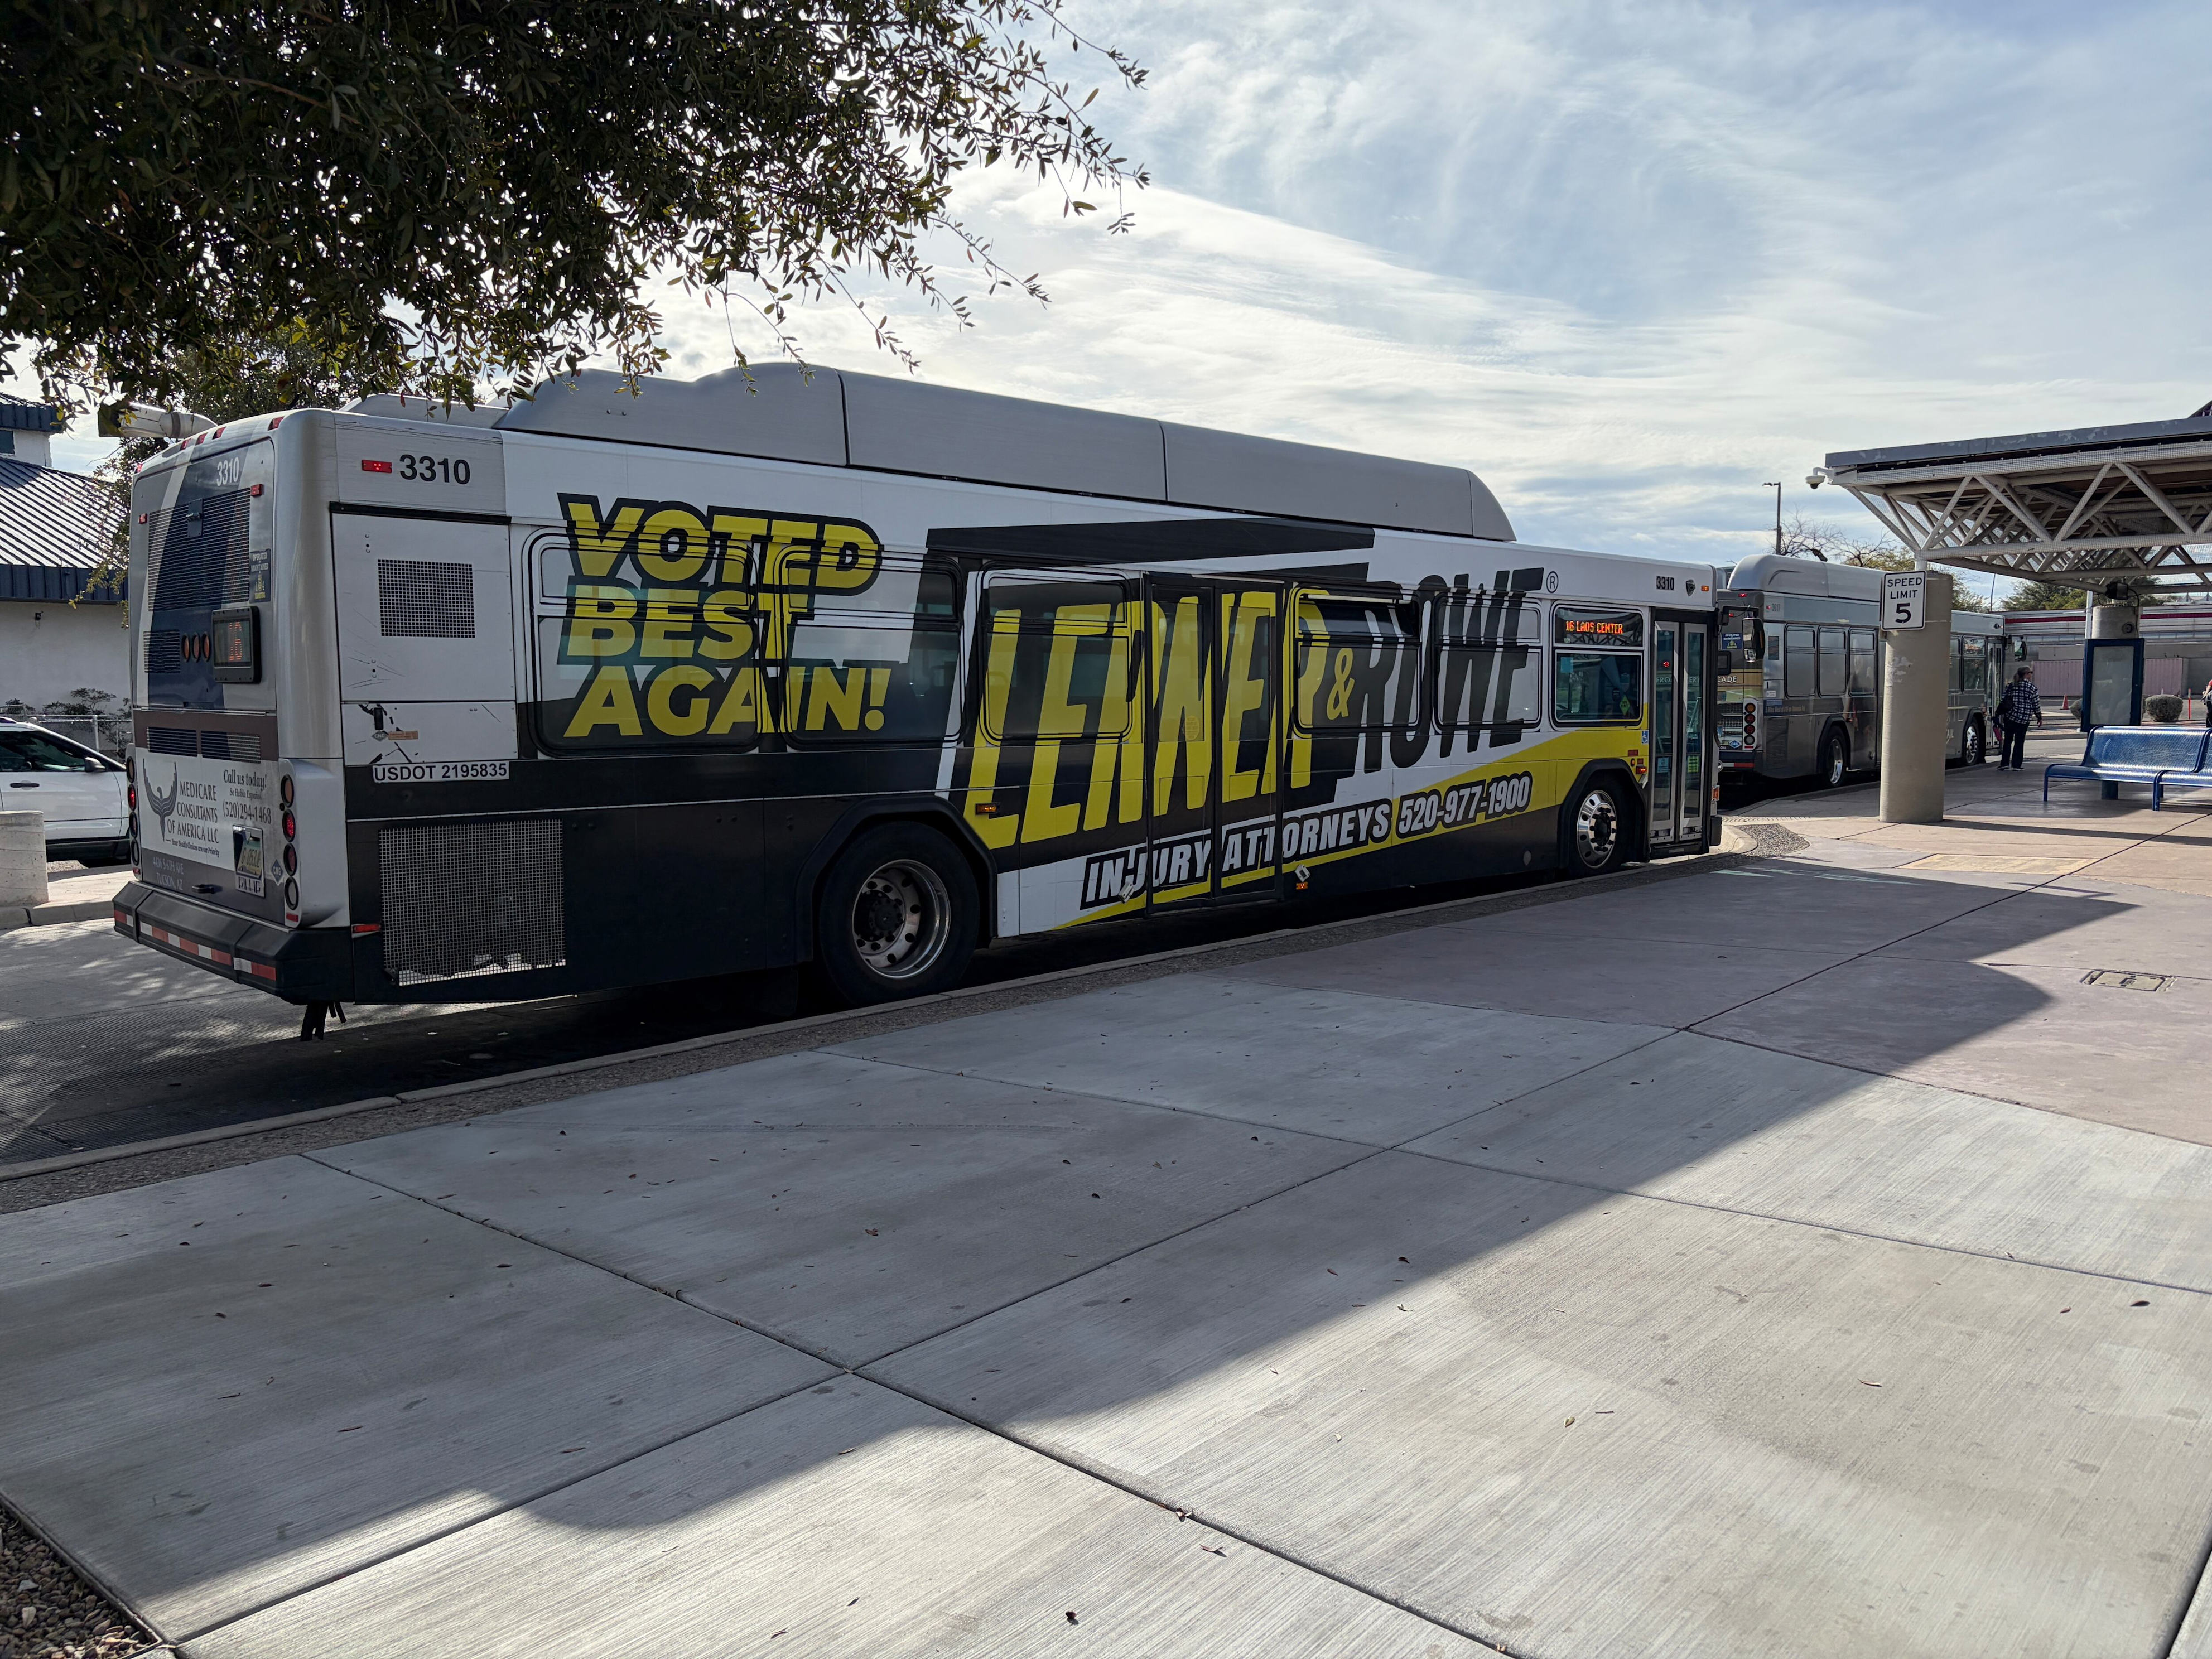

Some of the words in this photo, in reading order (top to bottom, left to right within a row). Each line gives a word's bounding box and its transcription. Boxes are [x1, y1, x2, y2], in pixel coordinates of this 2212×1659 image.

[216, 457, 239, 486] 3310
[399, 454, 470, 485] 3310
[568, 502, 879, 589] VOTED
[1656, 576, 1674, 590] 3310
[1887, 577, 1922, 587] SPEED
[1890, 590, 1918, 599] LIMIT
[567, 584, 809, 659] BEST
[1895, 603, 1911, 624] 5
[1565, 621, 1574, 631] 16
[1576, 621, 1595, 633] LAOS
[1596, 622, 1623, 634] CENTER
[229, 621, 243, 660] 16
[563, 665, 891, 738] AGAIN!
[962, 587, 1330, 849] LERNER
[1325, 647, 1356, 720] &
[1354, 567, 1544, 773] ROWE
[224, 769, 236, 784] Call
[237, 774, 244, 785] us
[246, 772, 267, 791] today!
[374, 765, 436, 781] USDOT
[441, 763, 507, 778] 2195835
[180, 781, 217, 802] MEDICARE
[177, 802, 218, 823] CONSULTANTS
[223, 799, 271, 824] (520)294-1468
[167, 819, 175, 834] OF
[177, 821, 206, 842] AMERICA
[207, 827, 219, 843] LLC
[1086, 838, 1211, 904] INJURY
[1222, 803, 1390, 872] ATTORNEYS
[1399, 774, 1532, 830] 520-977-1900
[179, 840, 187, 848] Health
[187, 842, 197, 851] Choices
[208, 847, 220, 858] Priority
